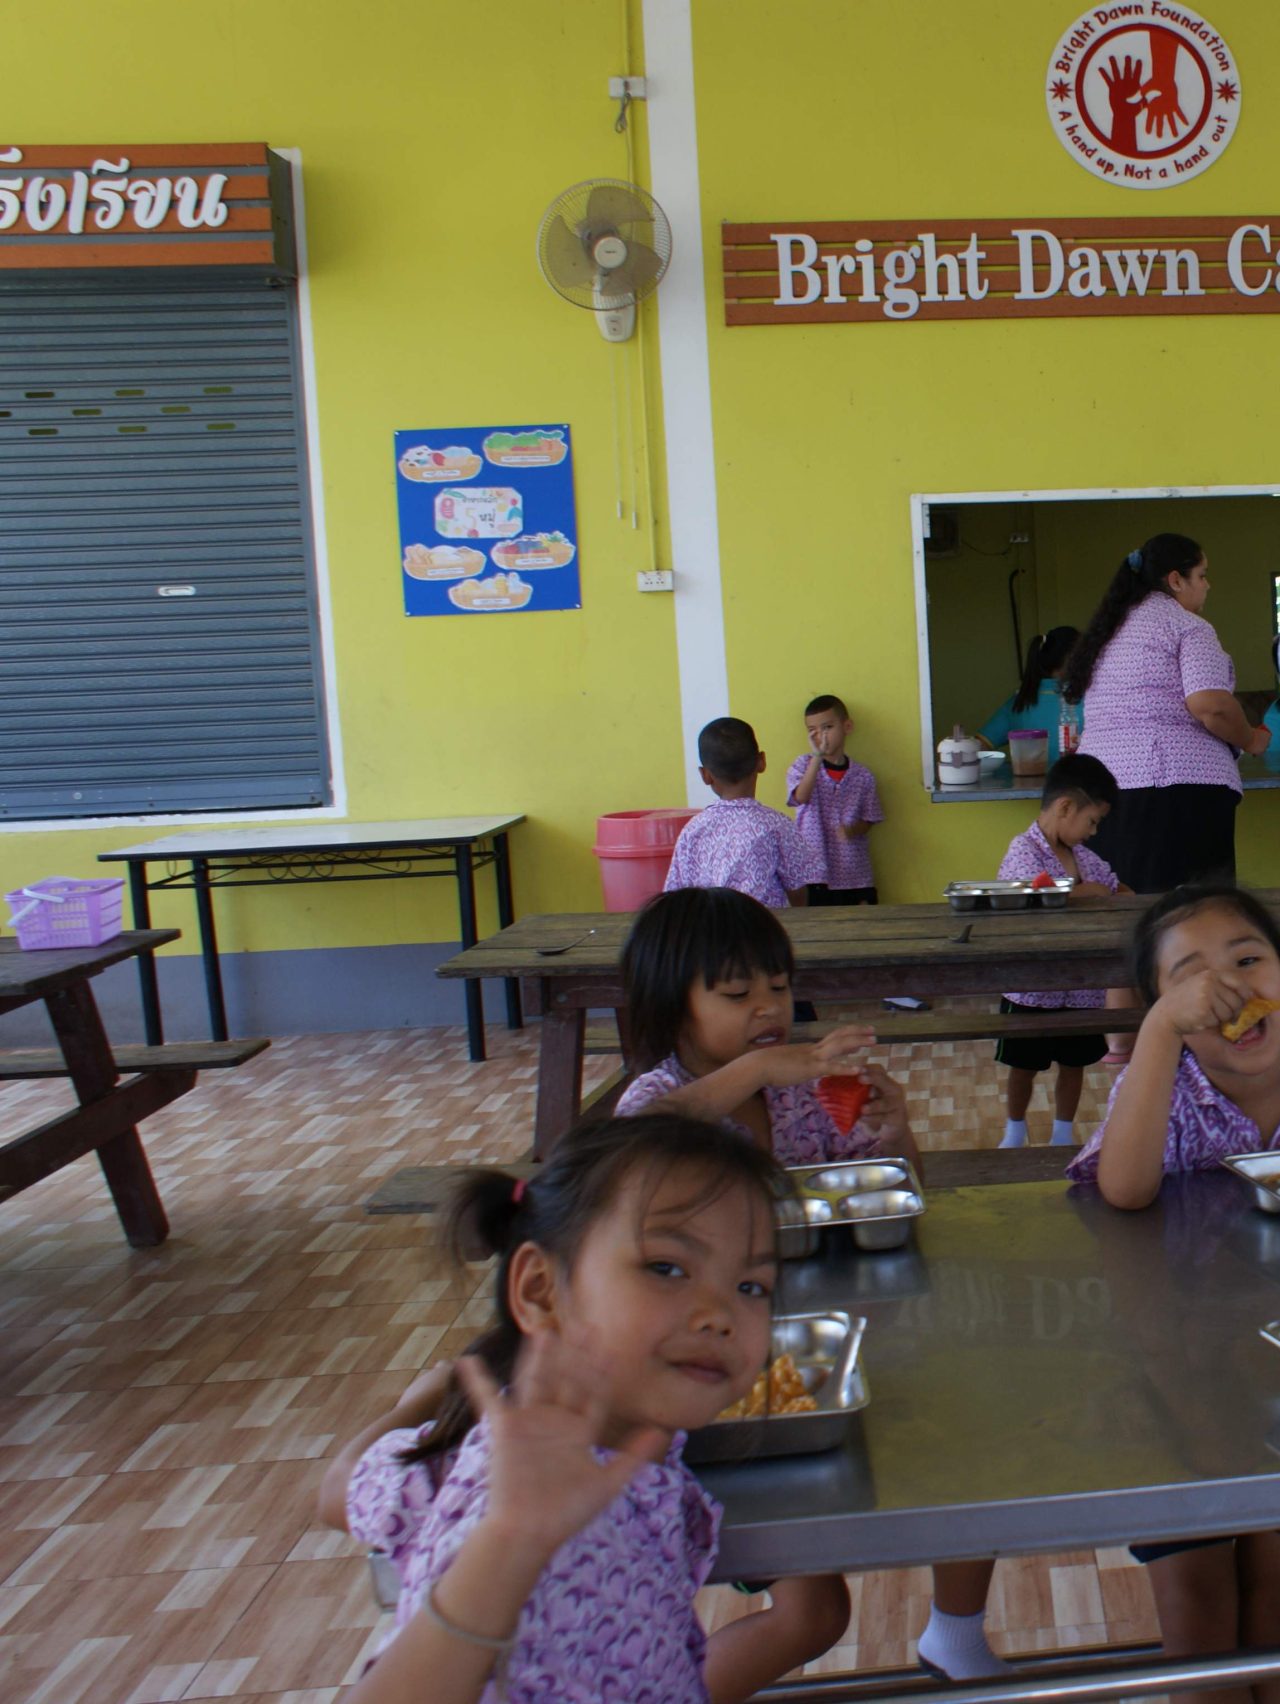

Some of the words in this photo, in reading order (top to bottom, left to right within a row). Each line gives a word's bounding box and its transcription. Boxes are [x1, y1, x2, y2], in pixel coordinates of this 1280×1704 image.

[1055, 20, 1096, 74] Bright
[1093, 4, 1144, 26] Dawn
[1151, 1, 1230, 71] Foundation
[1058, 110, 1072, 121] A
[1065, 124, 1098, 160] hand
[1096, 158, 1119, 176] up,
[1124, 164, 1151, 180] Not
[1158, 167, 1168, 178] a
[1174, 145, 1209, 173] hand
[1212, 114, 1228, 143] out
[0, 147, 228, 234] รงเรียน
[770, 232, 989, 319] Bright
[1011, 229, 1206, 300] Dawn
